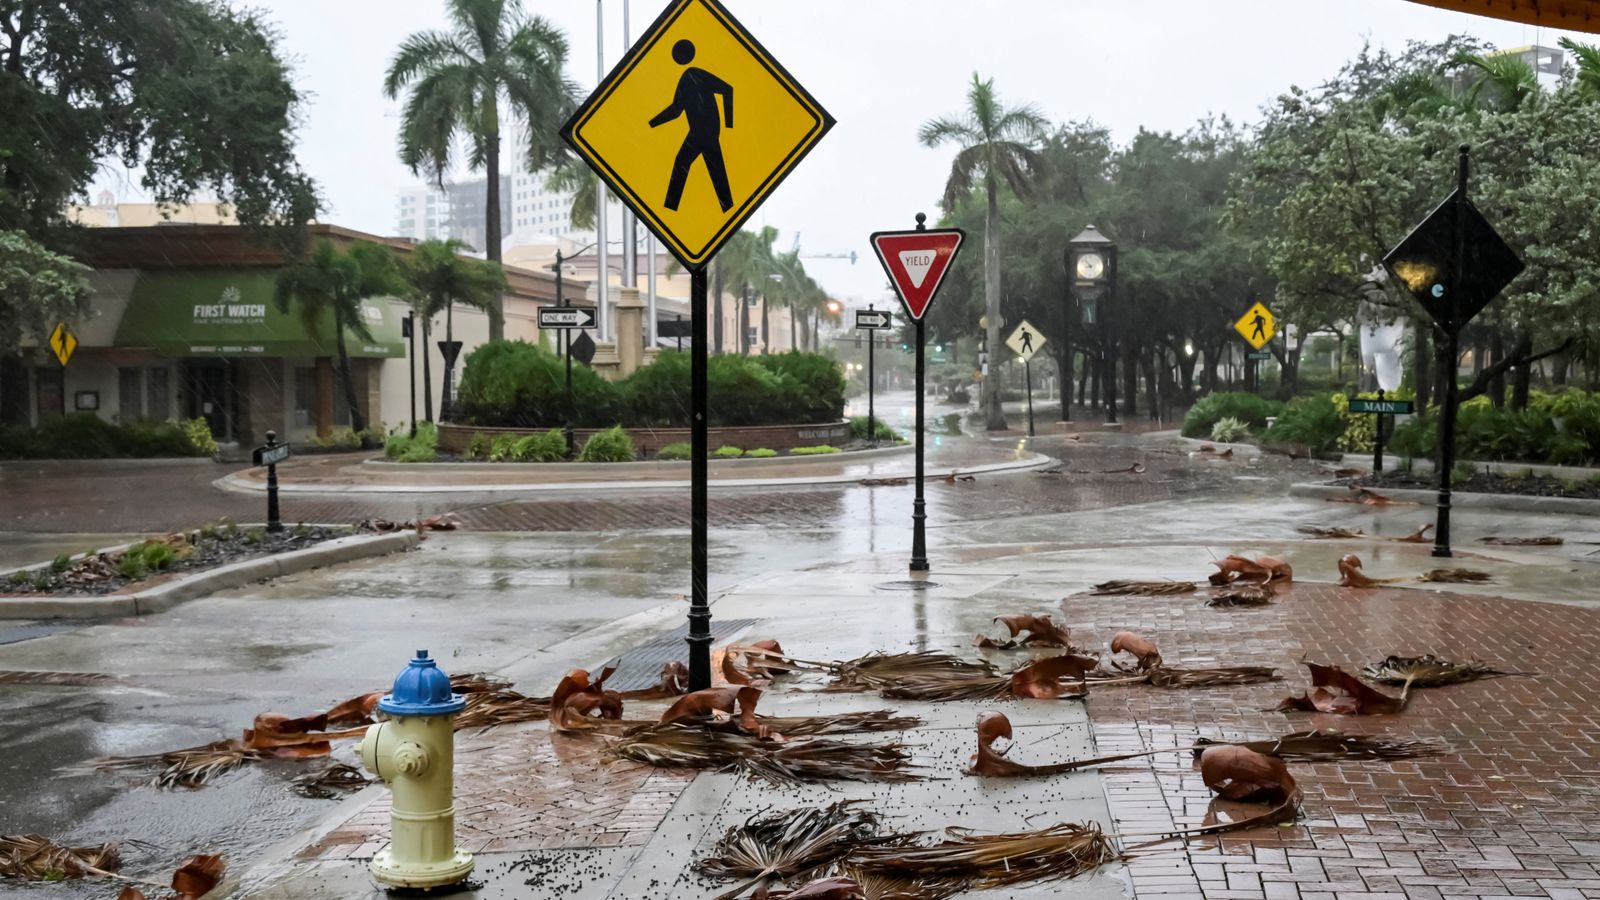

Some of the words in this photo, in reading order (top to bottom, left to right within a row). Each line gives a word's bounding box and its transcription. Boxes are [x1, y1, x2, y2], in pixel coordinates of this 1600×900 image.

[905, 256, 930, 266] YIELD
[194, 304, 226, 317] FIRST
[228, 304, 265, 317] WATCH
[1363, 401, 1394, 411] MAIN
